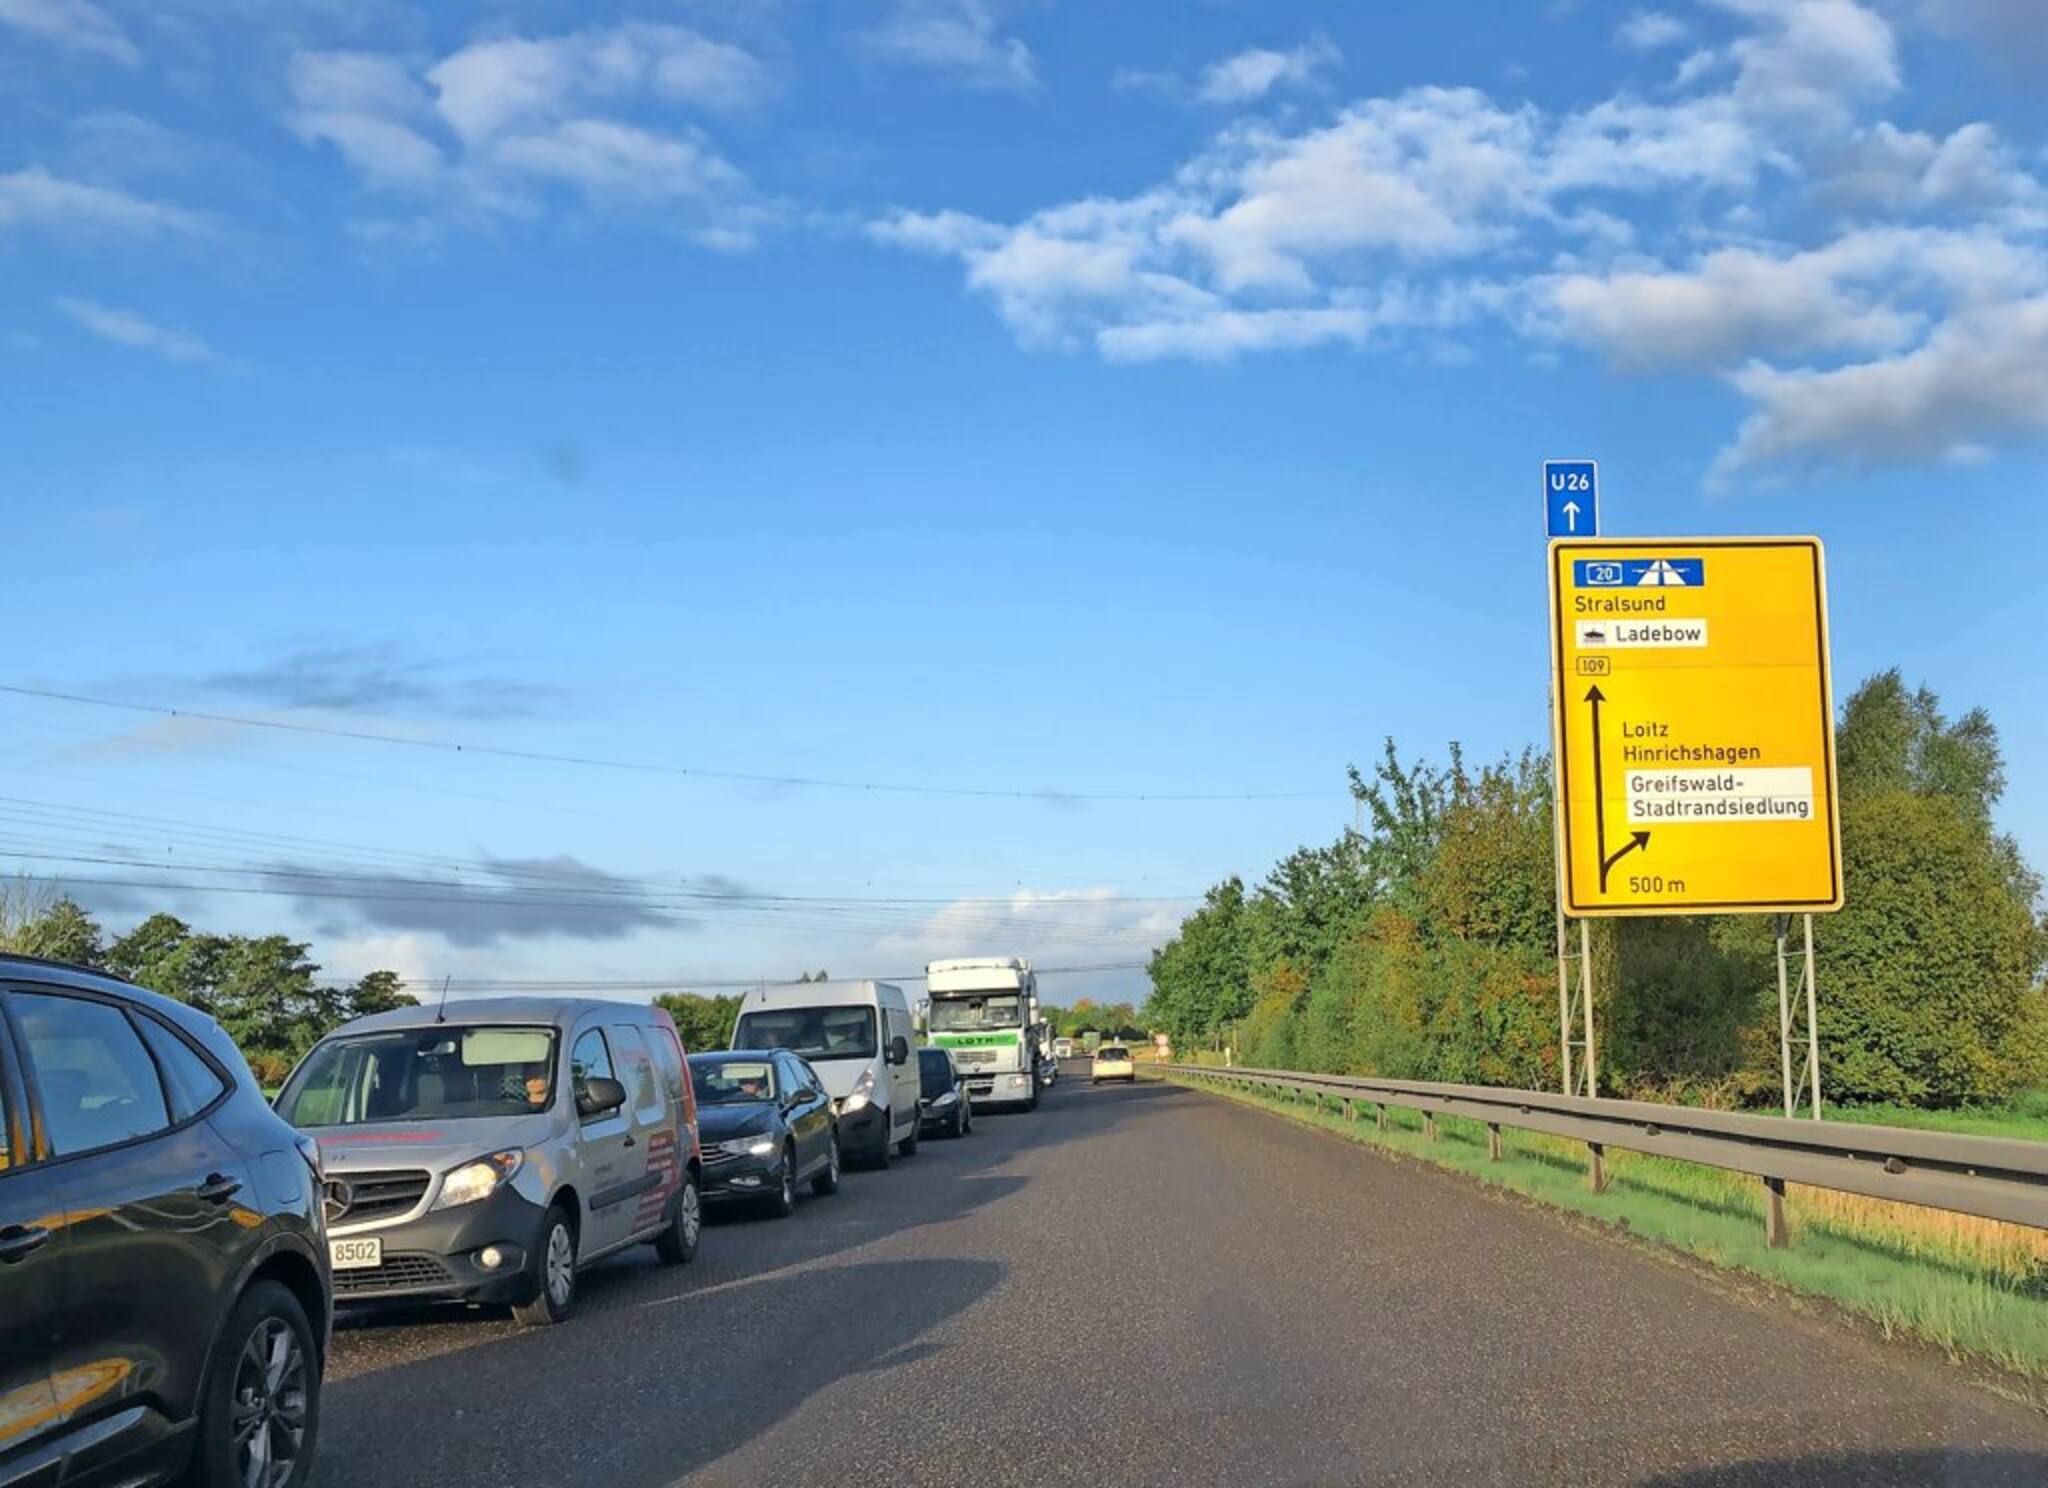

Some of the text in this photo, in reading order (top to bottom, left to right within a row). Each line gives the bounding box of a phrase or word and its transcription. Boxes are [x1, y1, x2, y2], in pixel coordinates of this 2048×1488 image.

[1595, 567, 1613, 581] 20
[1575, 595, 1666, 613] Stralsund
[1615, 625, 1702, 642] Ladebow
[1583, 659, 1605, 673] 109
[1623, 721, 1669, 738] Loitz
[1623, 745, 1760, 764] Hinrichshagen
[1631, 774, 1744, 793] Greifswald-
[1633, 797, 1809, 818] Stadtrandsiedlung
[1629, 876, 1685, 893] 500 m
[335, 1241, 376, 1262] 8502
